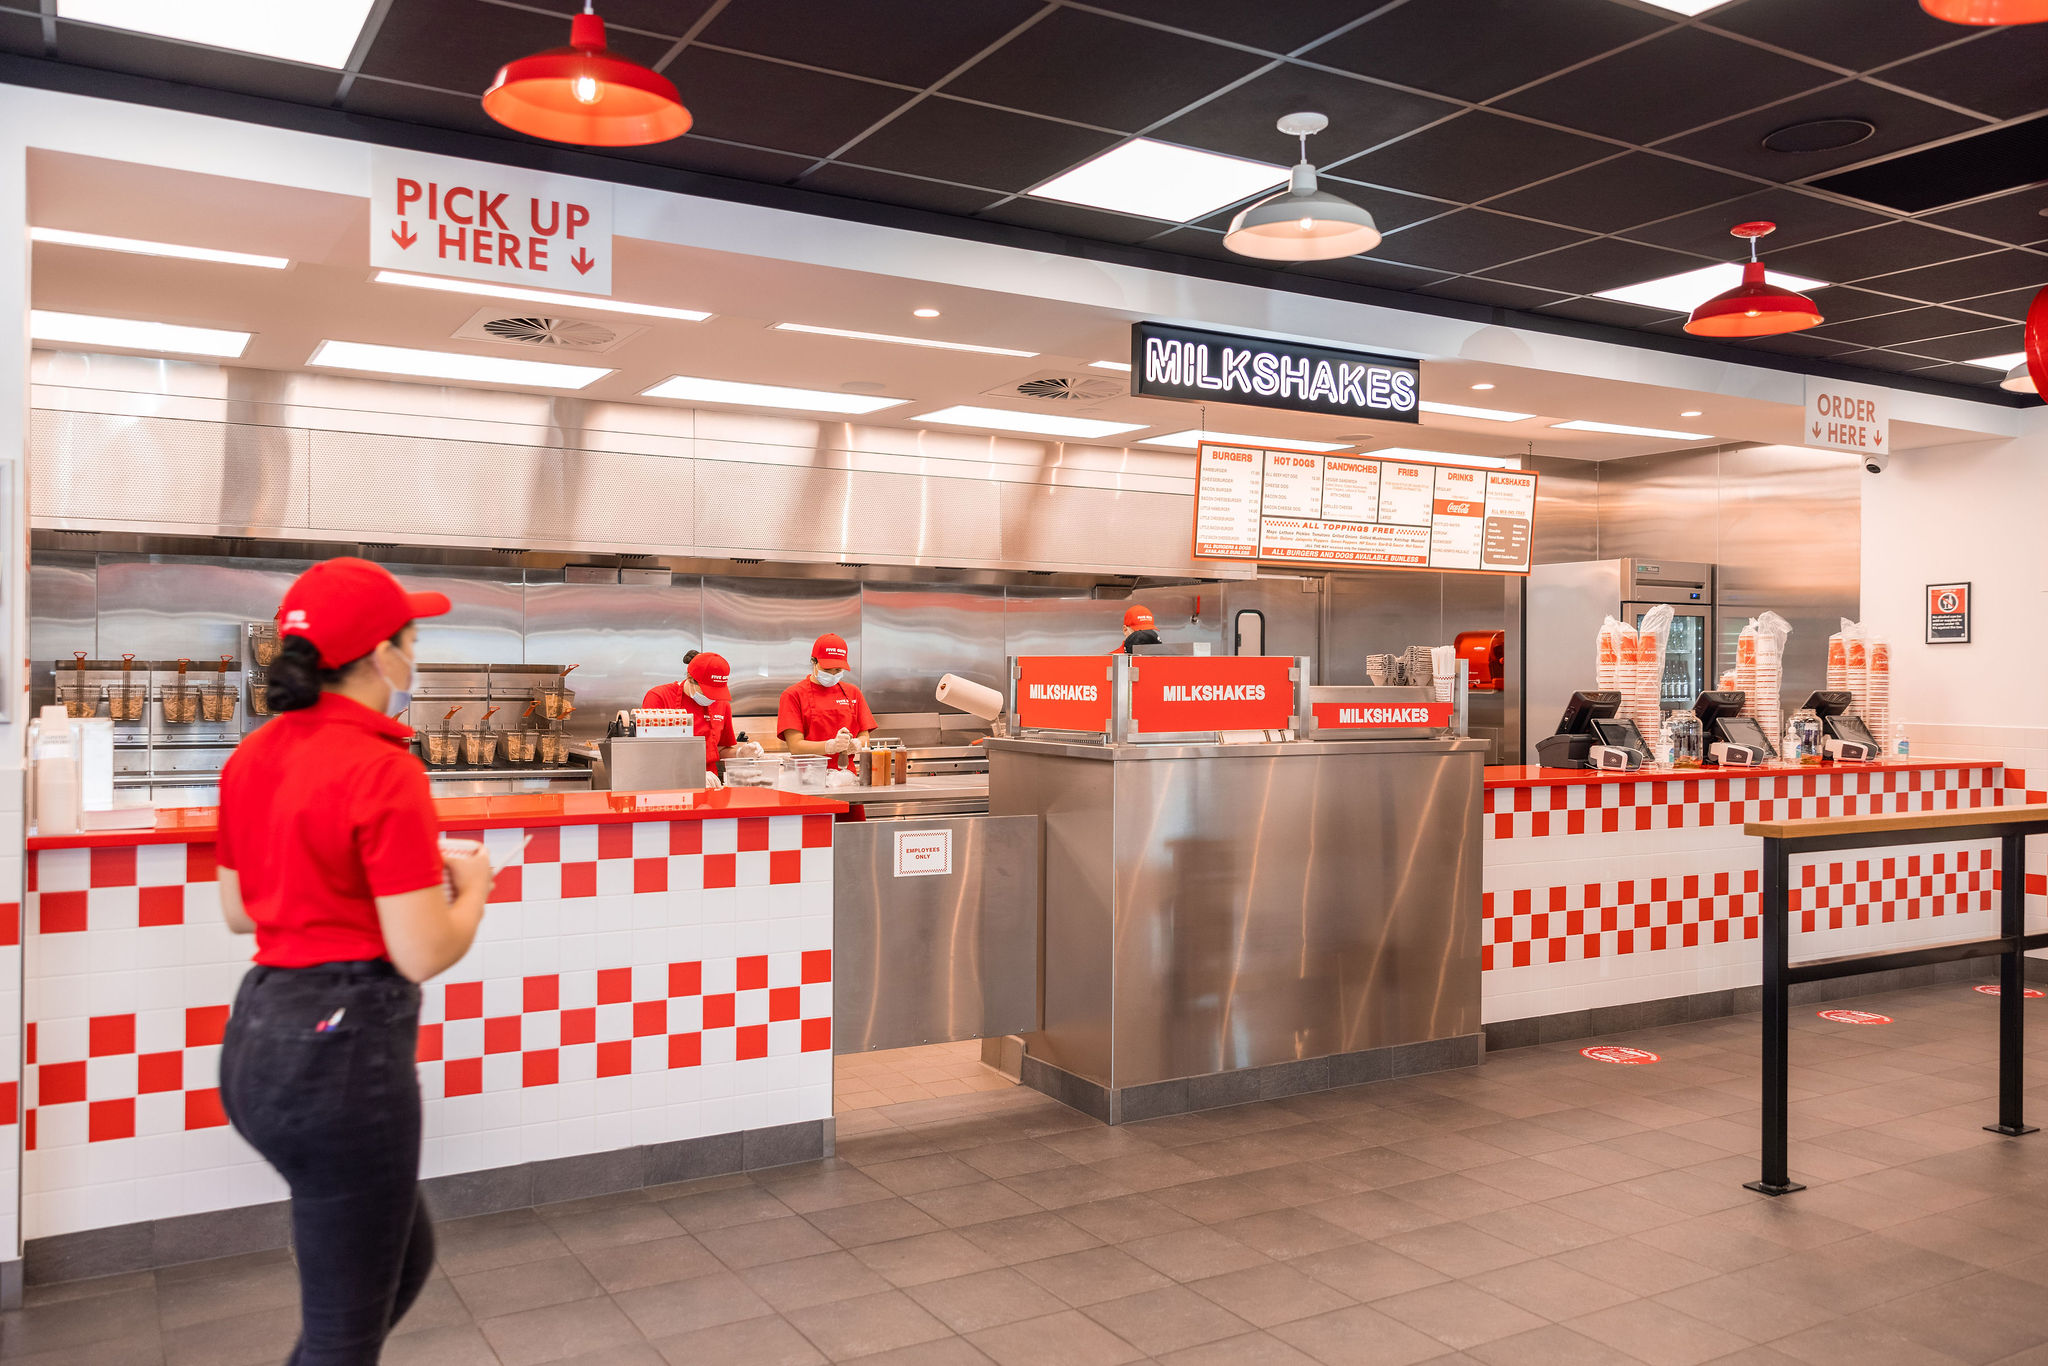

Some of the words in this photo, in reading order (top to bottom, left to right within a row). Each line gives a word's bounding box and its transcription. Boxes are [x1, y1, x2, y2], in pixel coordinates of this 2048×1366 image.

[397, 177, 510, 231] PICK
[531, 198, 590, 240] UP
[438, 223, 548, 272] HERE
[1146, 337, 1416, 412] MILKSHAKES
[1817, 393, 1876, 423] ORDER
[1827, 422, 1866, 446] HERE
[1212, 450, 1252, 462] BURGERS
[1274, 456, 1290, 466] HOT
[1292, 458, 1315, 468] DOGS
[1327, 461, 1378, 474] SANDWICHES
[1398, 468, 1418, 477] FRIES
[1448, 472, 1474, 482] DRINKS
[1490, 476, 1530, 487] MILKSHAKES
[1323, 524, 1369, 532] TOPPINGS
[1029, 683, 1098, 702] MILKSHAKES
[1163, 684, 1266, 702] MILKSHAKES
[1338, 707, 1429, 724] MILKSHAKES
